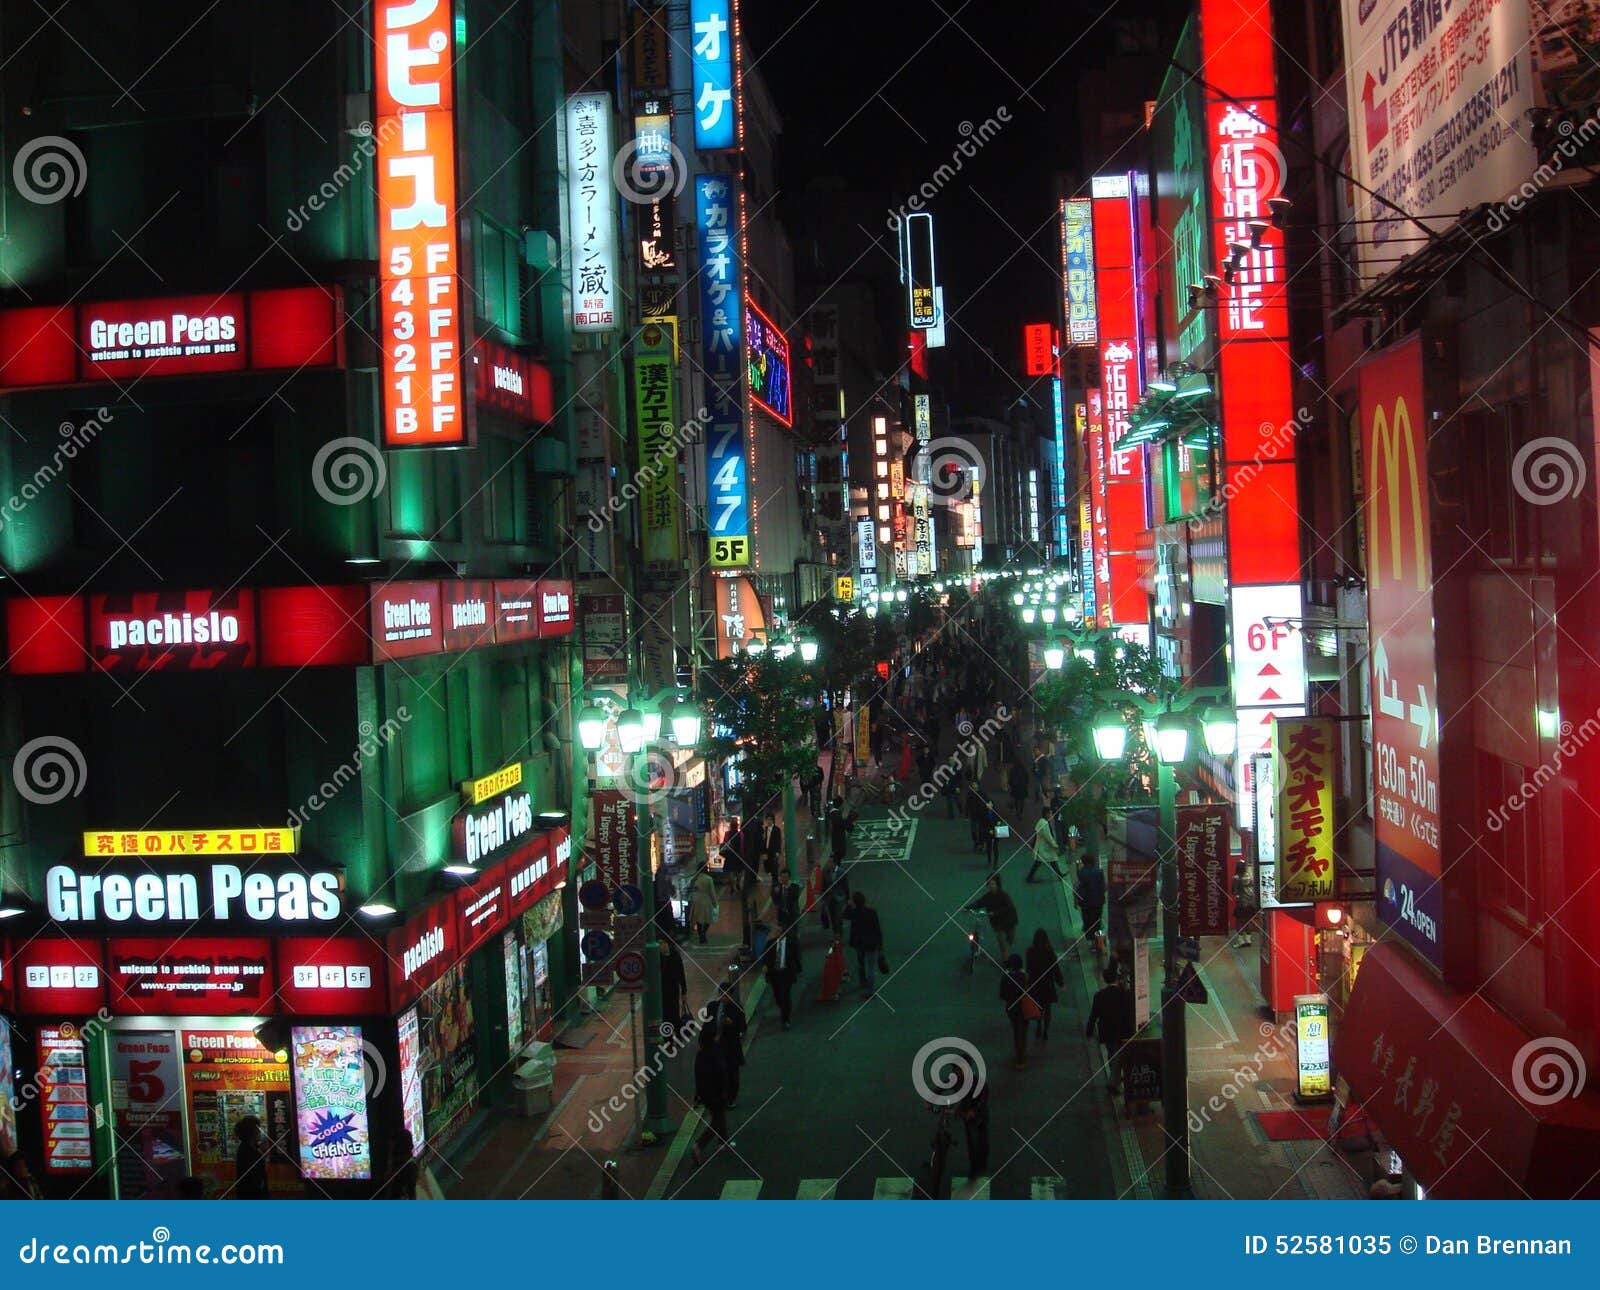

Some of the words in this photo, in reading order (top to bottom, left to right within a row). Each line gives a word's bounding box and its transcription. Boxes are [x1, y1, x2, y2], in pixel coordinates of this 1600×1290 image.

[1378, 0, 1451, 85] JTB新宿
[694, 13, 731, 131] オケ
[645, 101, 660, 115] 5F
[1220, 143, 1233, 218] TAITO
[391, 243, 451, 278] 5F
[391, 277, 451, 308] 4F
[1224, 226, 1240, 331] SION
[575, 311, 614, 326] 南口店
[583, 298, 605, 310] 新宿
[90, 316, 167, 350] Green
[172, 314, 236, 344] Peas
[393, 308, 453, 341] 3F
[394, 341, 454, 374] 2F
[395, 373, 455, 405] 1F
[396, 405, 457, 435] BF
[714, 539, 745, 562] 5F
[384, 600, 411, 629] Green
[410, 598, 431, 626] Peas
[452, 598, 486, 630] pachislo
[109, 612, 239, 650] pachislo
[1248, 622, 1290, 653] 6F
[1377, 741, 1407, 799] 130m
[1410, 755, 1438, 815] 50m
[96, 832, 284, 854] 究極のパチスロ店
[466, 806, 504, 864] Green
[505, 793, 532, 841] Peas
[617, 837, 632, 886] Christma
[46, 865, 199, 922] Green
[211, 864, 342, 922] Peas
[403, 926, 445, 981] pachislo
[29, 971, 46, 983] BF
[55, 971, 70, 983] 1F
[79, 971, 95, 983] 2F
[119, 964, 158, 976] welcome
[161, 964, 171, 976] to
[173, 964, 212, 976] pachislo
[214, 965, 240, 976] green
[243, 965, 265, 976] peas
[298, 971, 314, 983] 3F
[324, 971, 341, 983] 4F
[350, 970, 367, 983] 5F
[140, 981, 245, 992] www.greenpeas.co.jp
[189, 1035, 224, 1049] Green
[128, 1059, 165, 1104] 5
[312, 1142, 362, 1159] CHANCE
